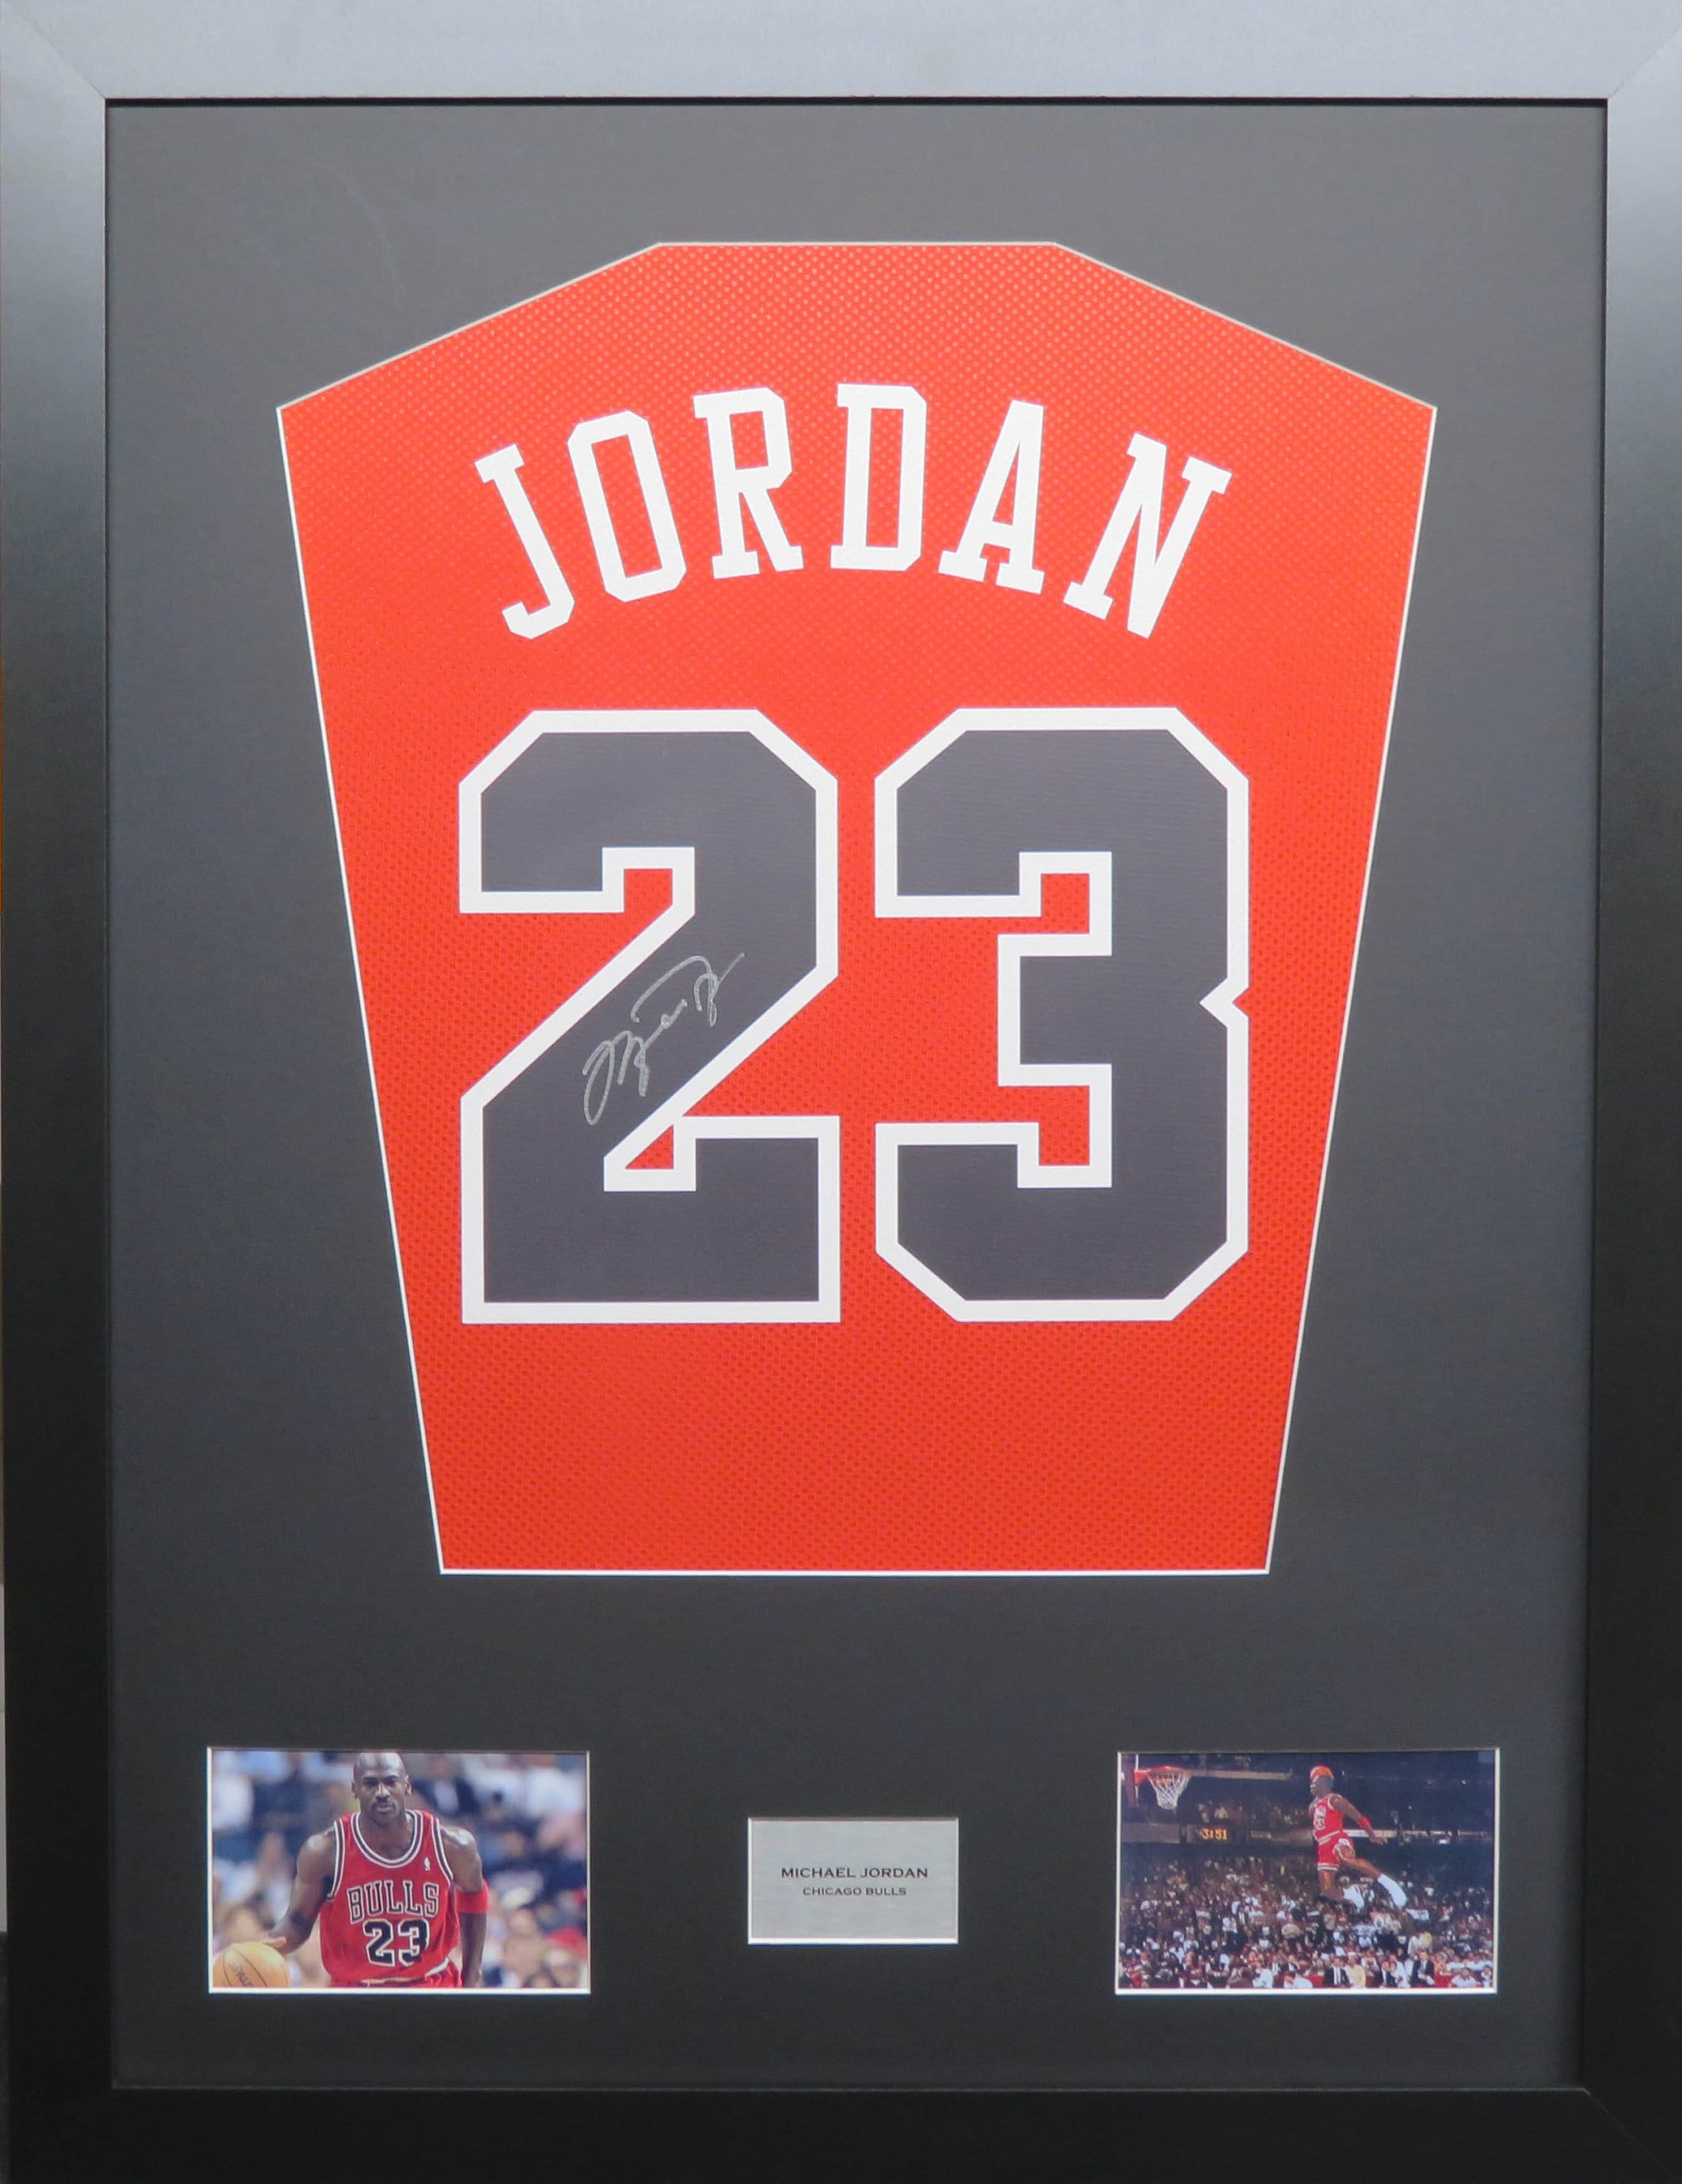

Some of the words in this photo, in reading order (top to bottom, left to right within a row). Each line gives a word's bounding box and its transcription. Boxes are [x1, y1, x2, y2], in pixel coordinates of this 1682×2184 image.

[475, 383, 1232, 639] JORDAN
[459, 707, 1249, 1324] 23
[781, 1867, 856, 1878] MICHAEL
[860, 1867, 929, 1878] JORDAN
[802, 1886, 862, 1896] CHICAGO
[865, 1886, 907, 1896] BULLS
[346, 1880, 439, 1924] BULLS
[362, 1918, 429, 1967] 23
